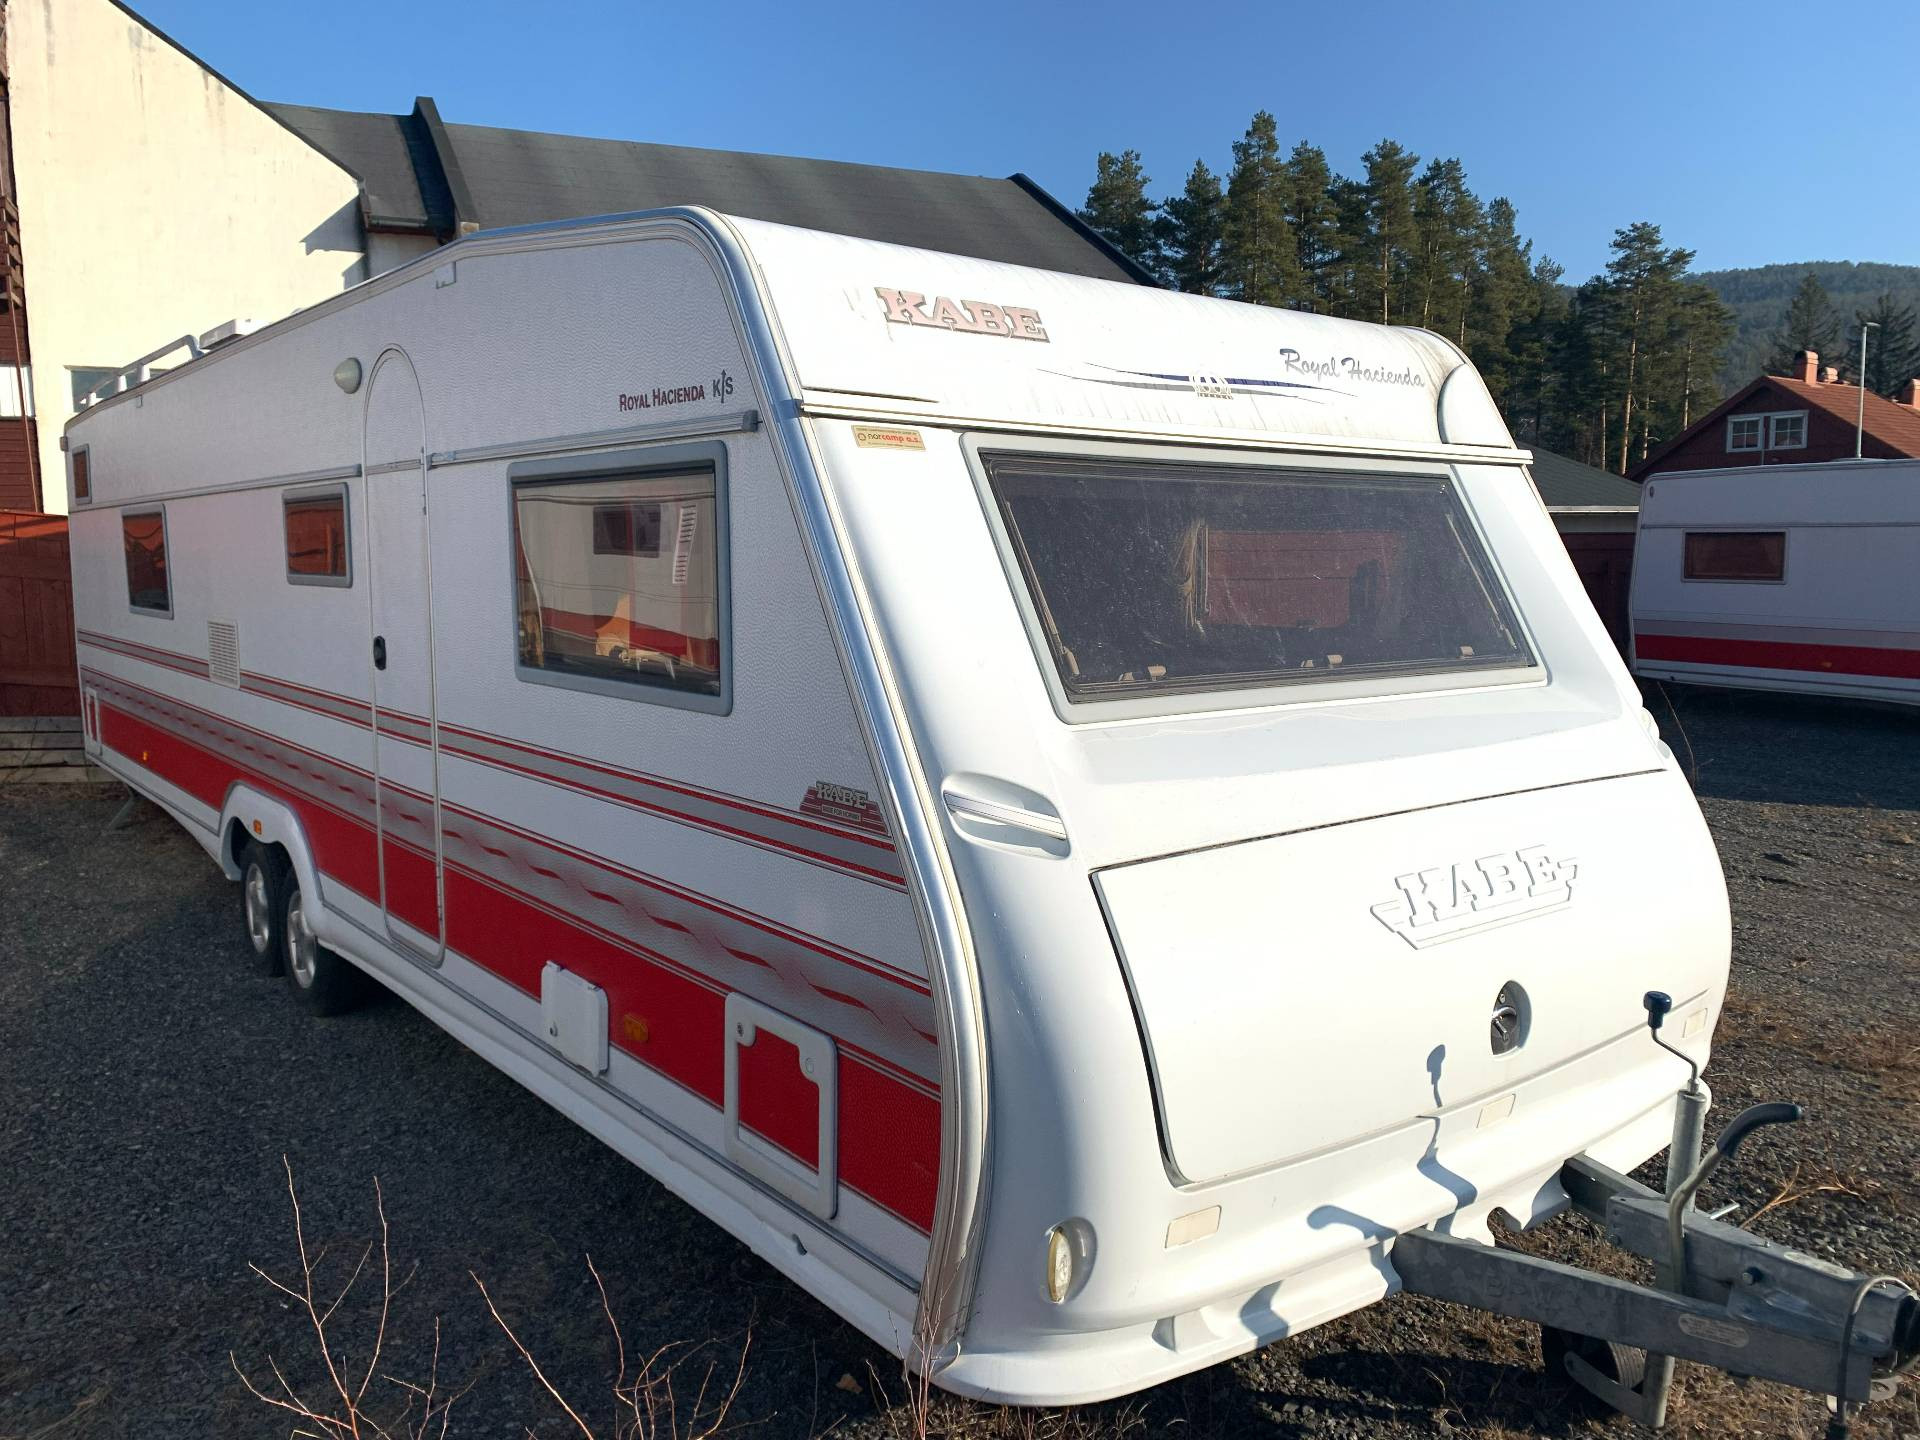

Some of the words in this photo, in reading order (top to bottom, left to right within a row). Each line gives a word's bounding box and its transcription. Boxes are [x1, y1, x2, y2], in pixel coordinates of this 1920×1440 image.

[874, 287, 1050, 343] KABE
[1279, 348, 1340, 382] Royal
[1341, 357, 1426, 387] Hacienda
[816, 781, 868, 809] KABE
[1395, 844, 1566, 927] KABE
